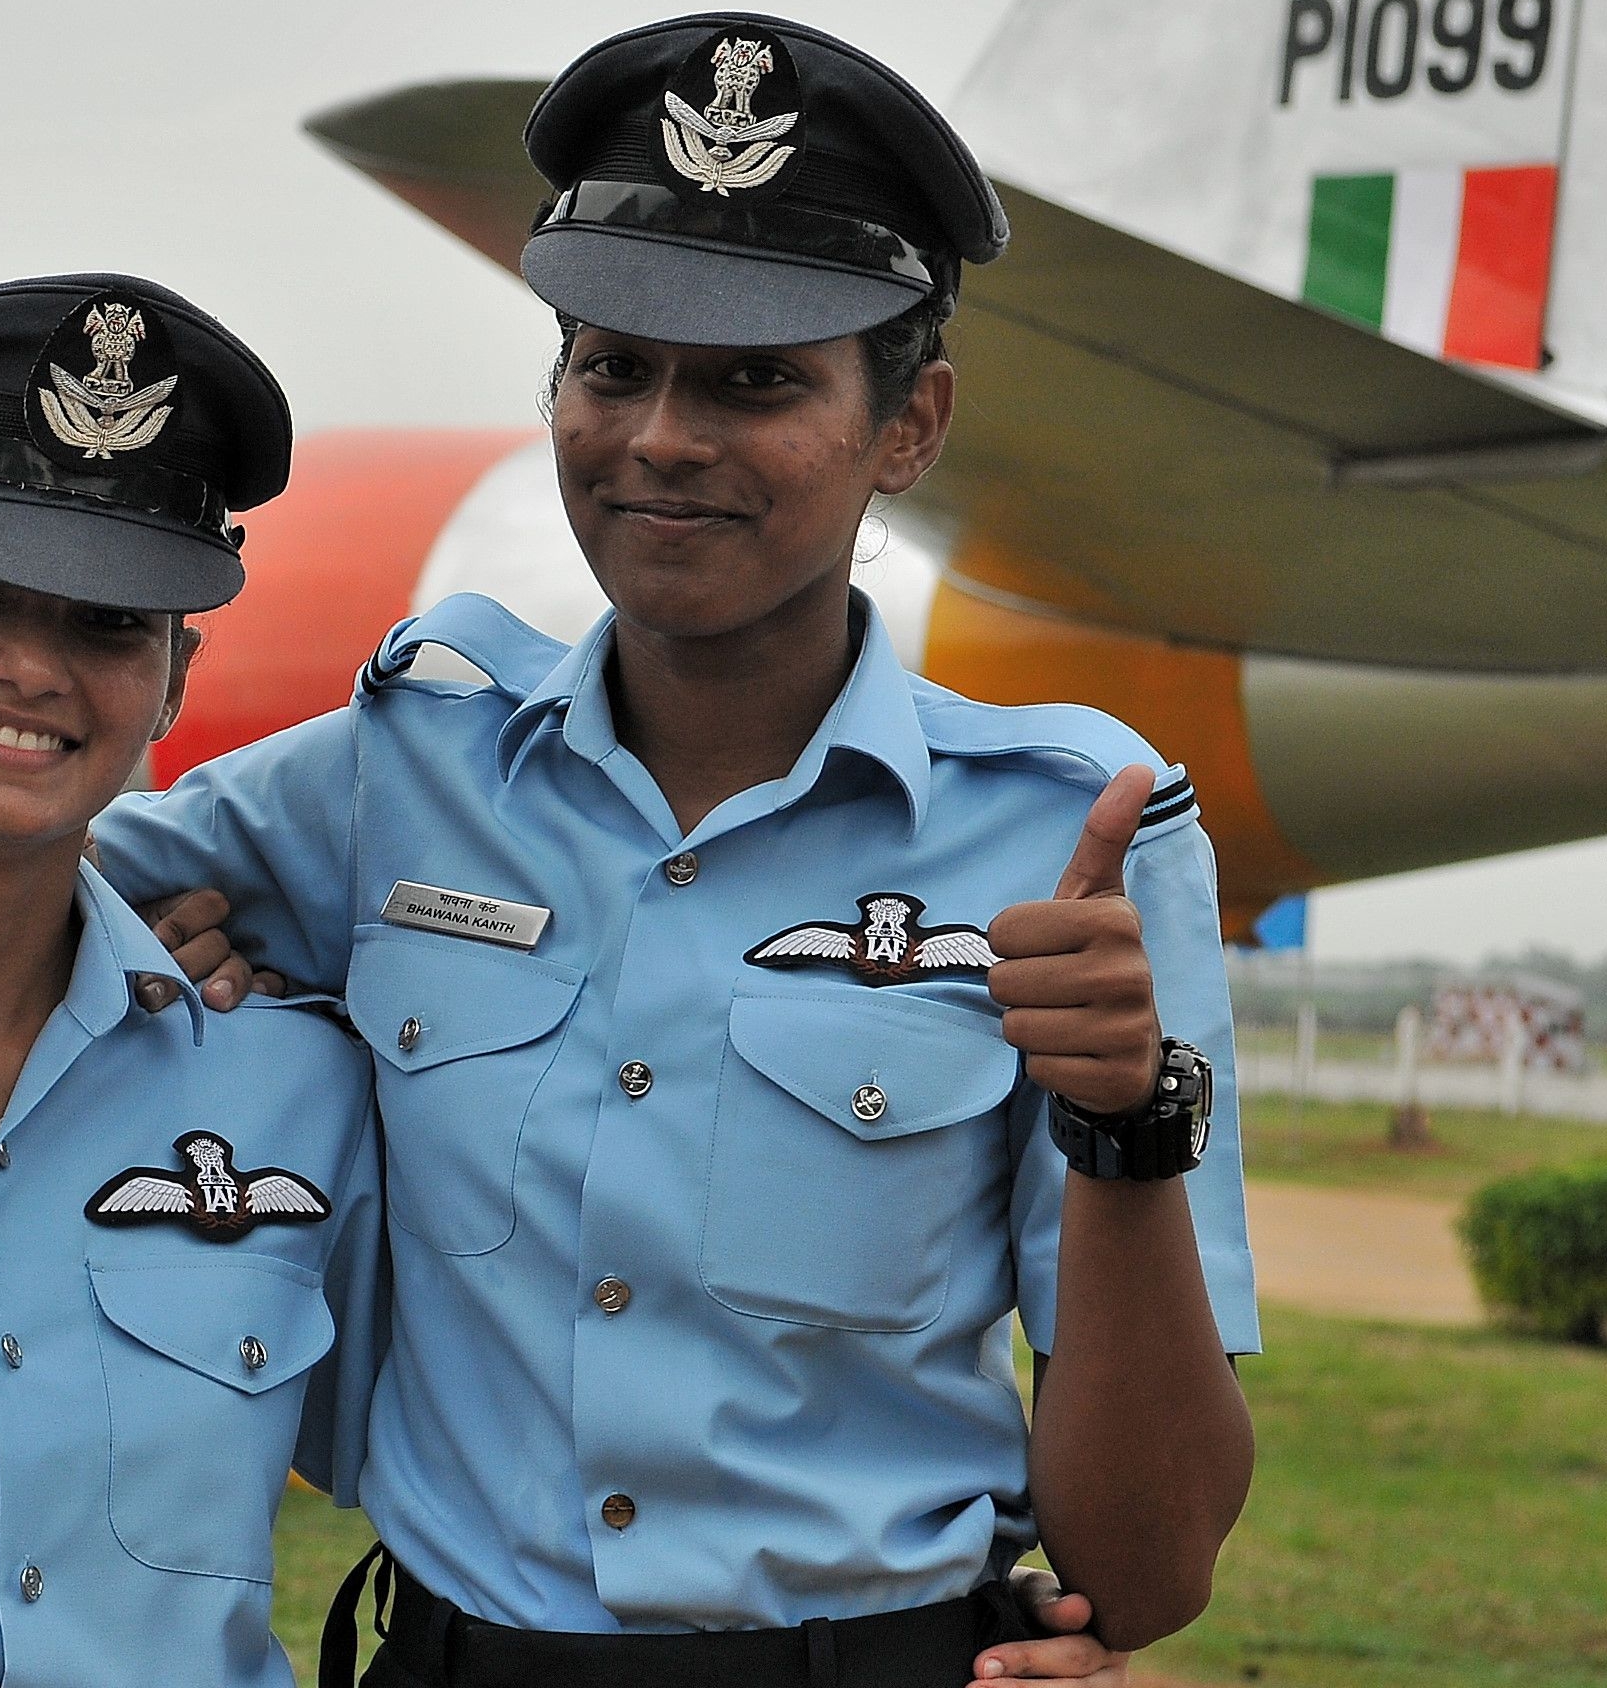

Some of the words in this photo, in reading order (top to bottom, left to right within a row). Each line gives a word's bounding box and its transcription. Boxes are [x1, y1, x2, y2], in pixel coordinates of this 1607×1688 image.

[406, 903, 469, 925] BHAWANA
[472, 916, 516, 934] KANTH
[479, 901, 500, 913] कंठ
[865, 936, 907, 964] IAF
[200, 1184, 238, 1213] IAF
